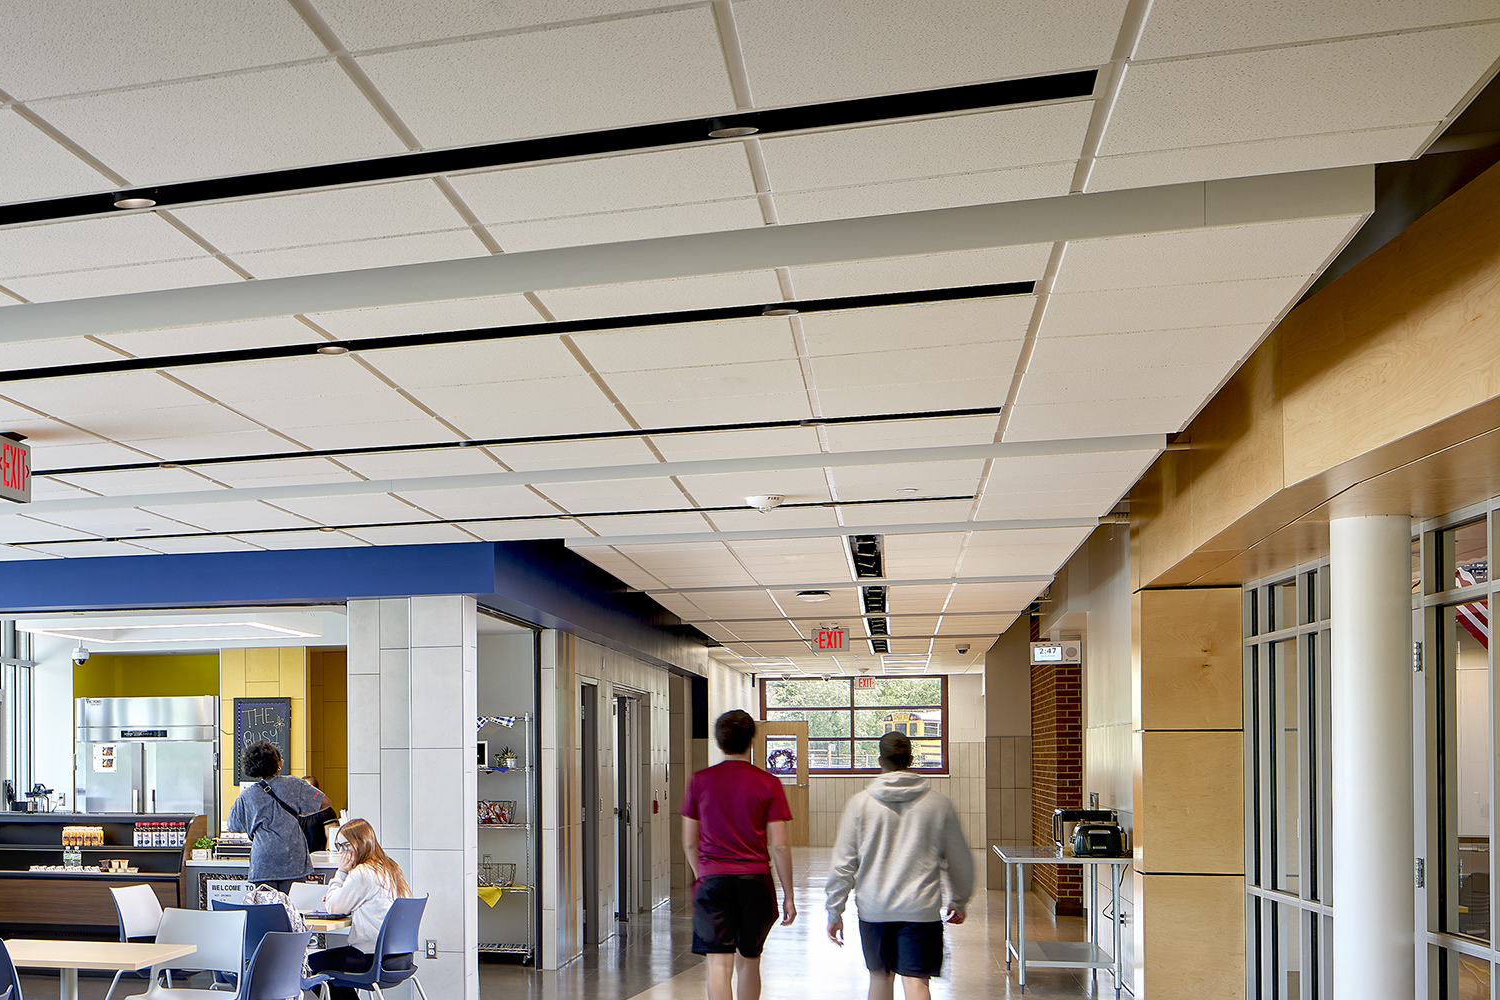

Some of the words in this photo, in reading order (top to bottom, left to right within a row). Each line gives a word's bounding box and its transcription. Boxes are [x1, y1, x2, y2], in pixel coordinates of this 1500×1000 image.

[3, 443, 26, 491] EXIT
[819, 631, 843, 648] EXIT
[858, 678, 872, 687] EXIT
[242, 707, 275, 729] THE
[211, 884, 241, 892] WELCOME
[245, 884, 254, 892] TO
